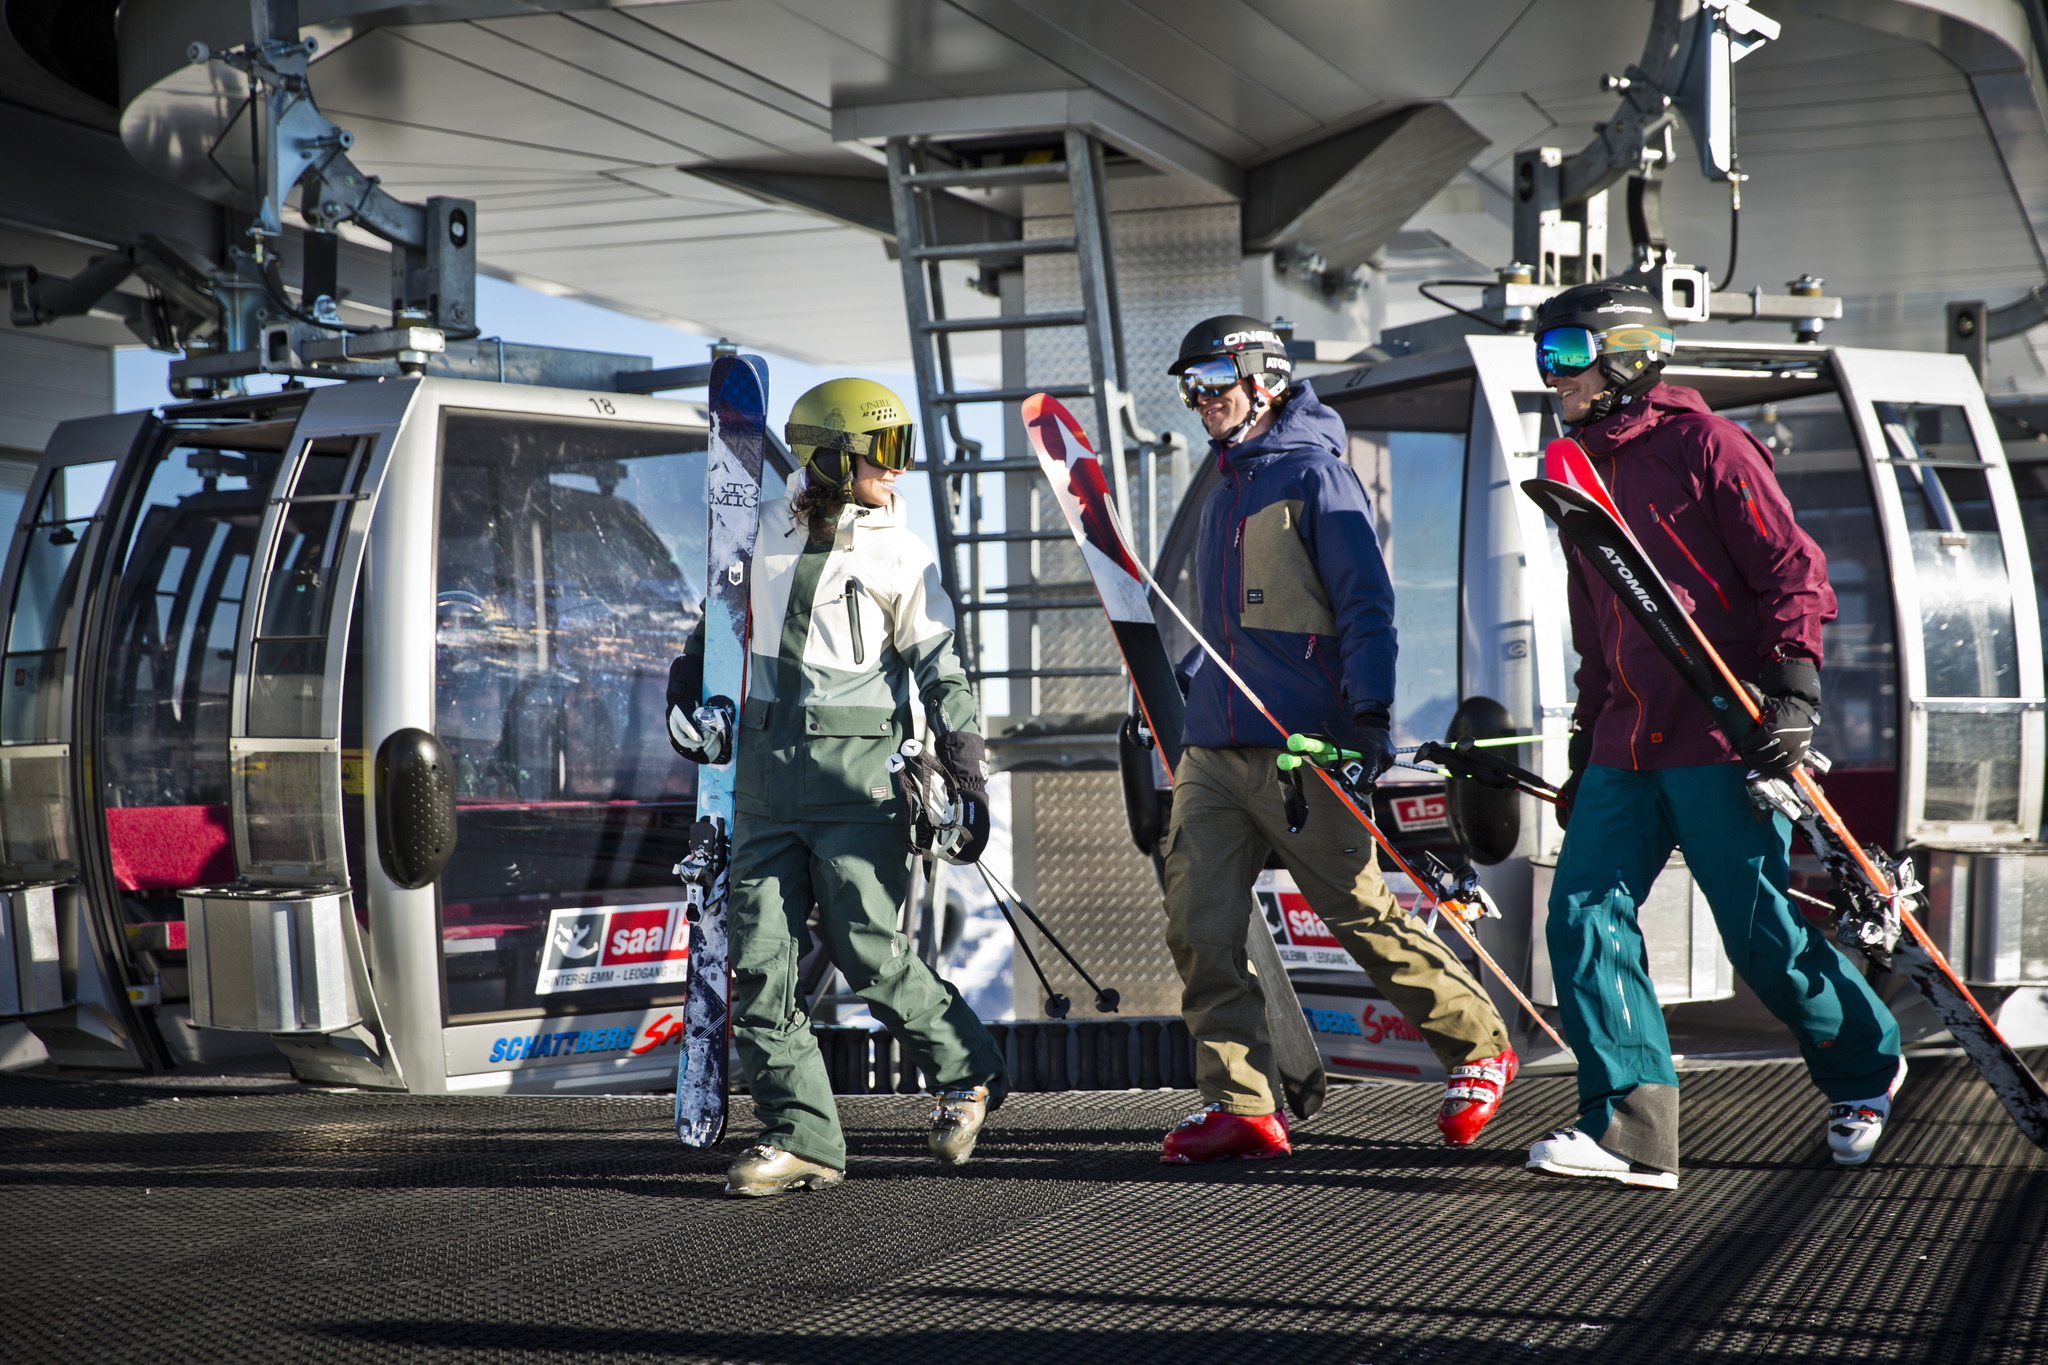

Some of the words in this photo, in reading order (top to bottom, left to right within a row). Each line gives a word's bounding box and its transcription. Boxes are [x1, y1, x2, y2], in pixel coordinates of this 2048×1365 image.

[589, 398, 615, 415] 18
[1599, 545, 1658, 613] ATOMIC
[1658, 618, 1681, 647] VANTAGE
[1288, 909, 1334, 938] saa
[489, 1025, 637, 1063] SCHATTBERG
